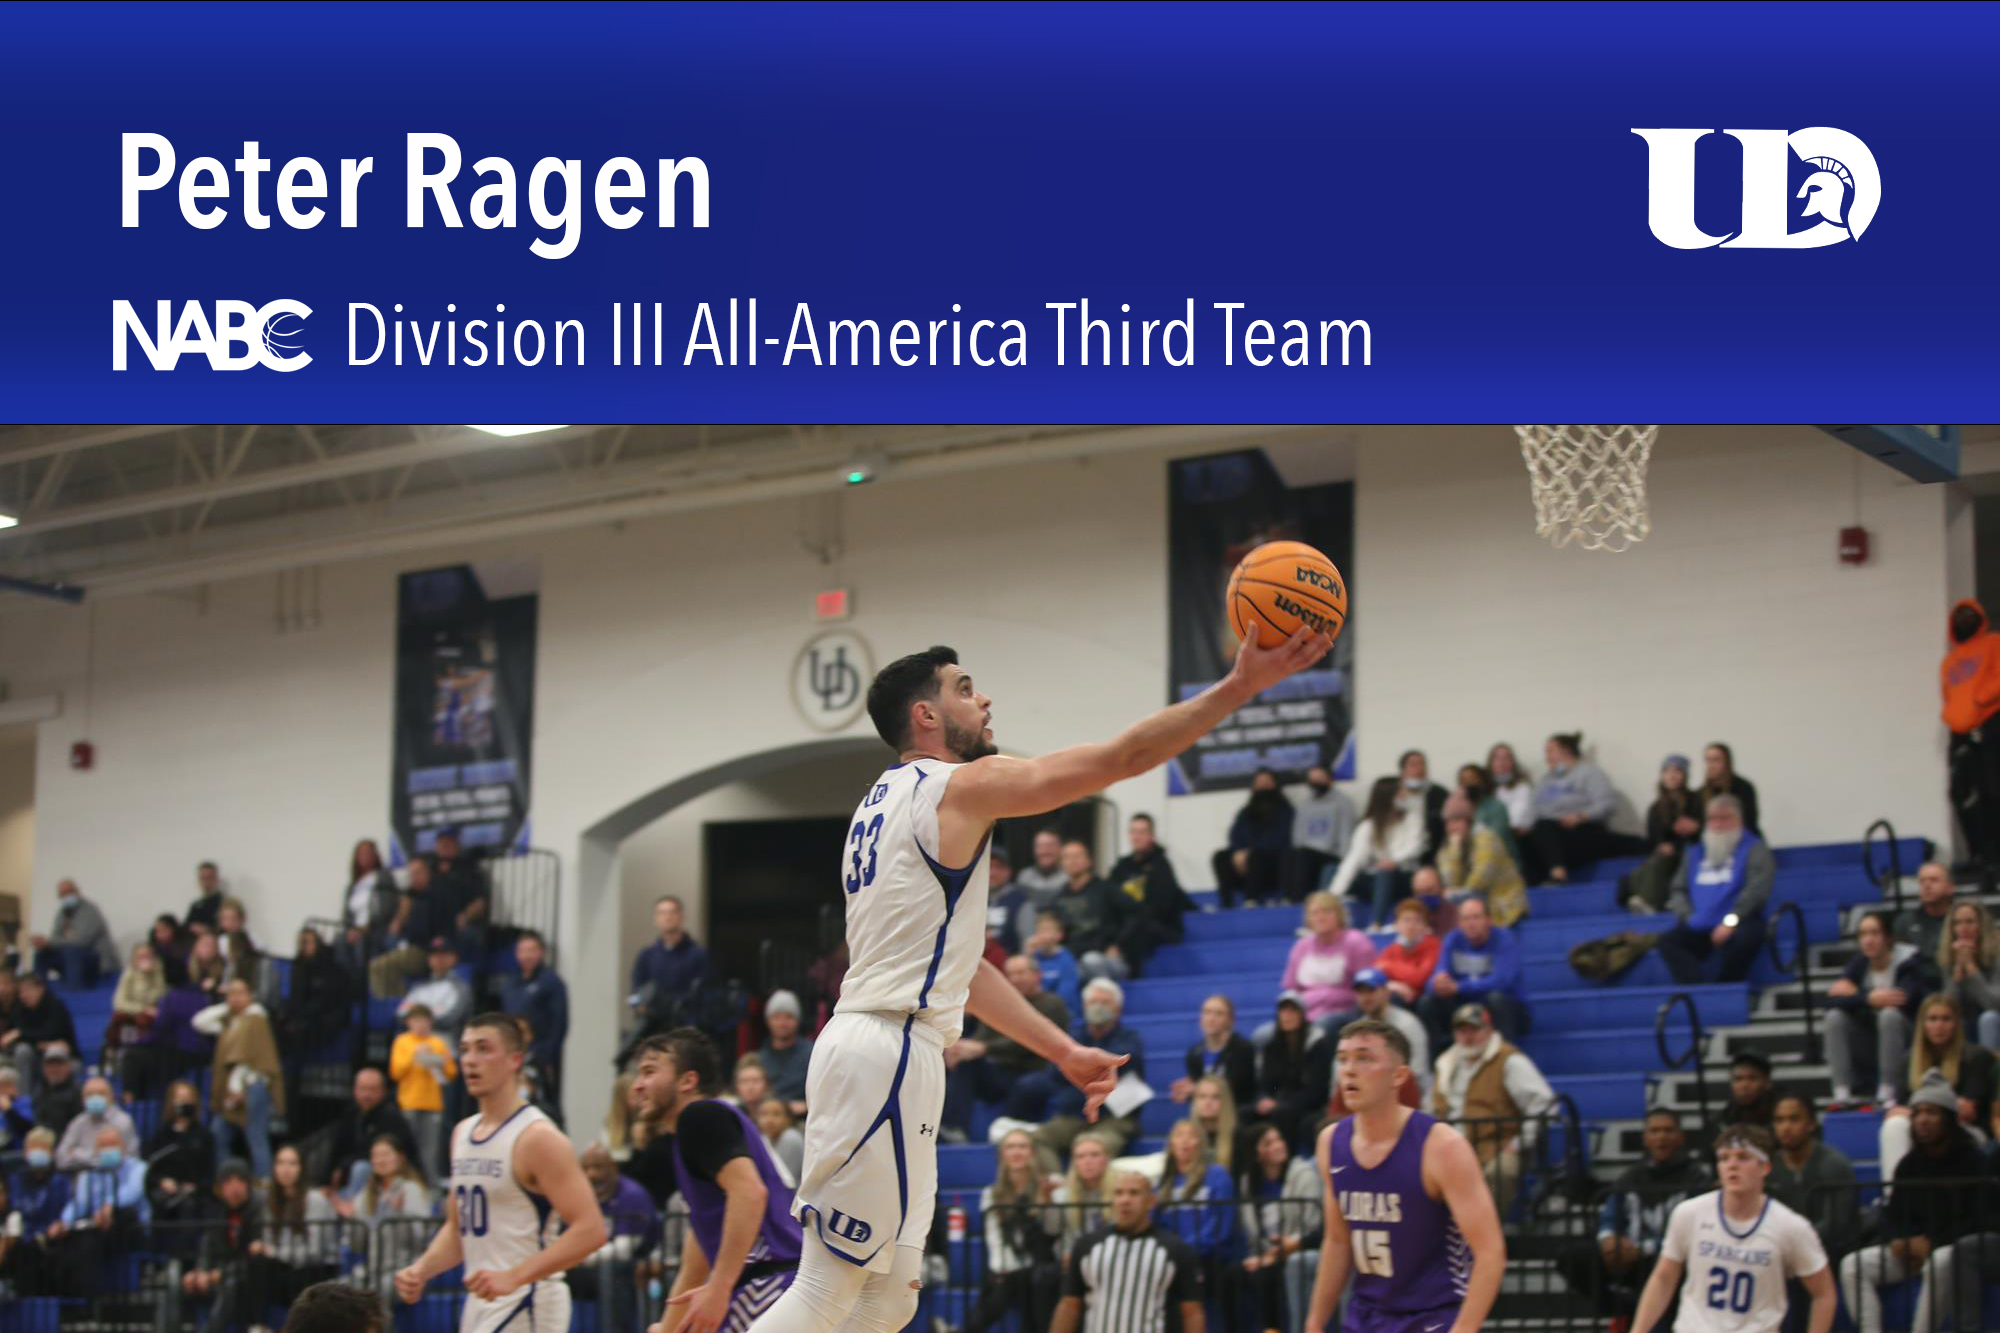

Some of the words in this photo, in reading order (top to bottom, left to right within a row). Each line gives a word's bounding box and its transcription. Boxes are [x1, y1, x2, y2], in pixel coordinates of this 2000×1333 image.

[1296, 565, 1341, 600] NCAA
[846, 813, 884, 894] 33
[457, 1184, 489, 1237] 30
[1339, 1190, 1402, 1223] LORAS
[1352, 1229, 1394, 1277] 15
[1698, 1240, 1771, 1267] SPARTANS
[1707, 1265, 1756, 1315] 20
